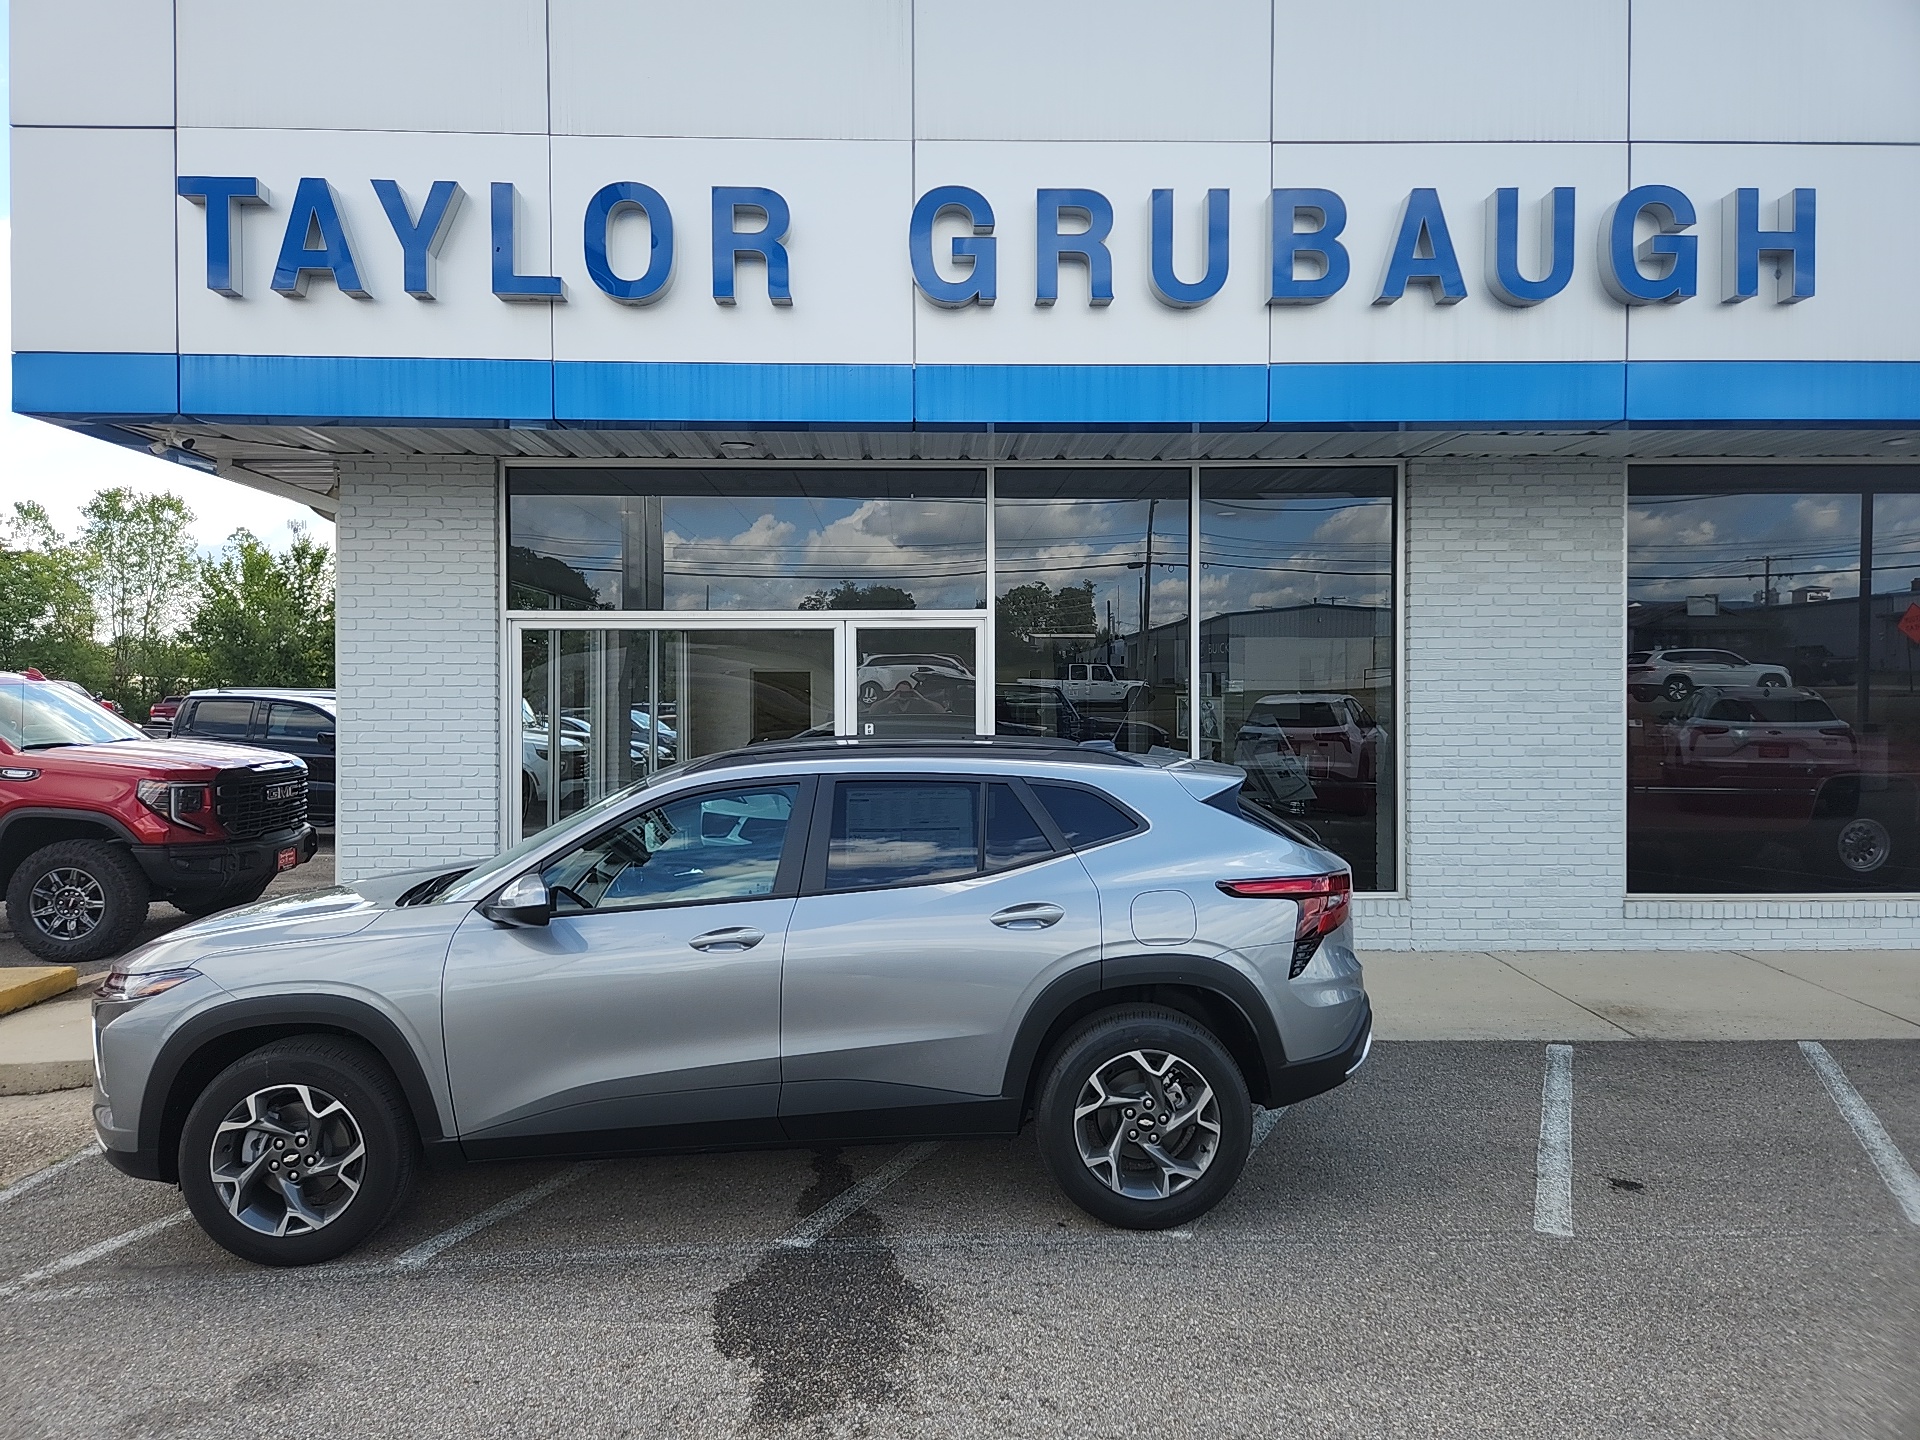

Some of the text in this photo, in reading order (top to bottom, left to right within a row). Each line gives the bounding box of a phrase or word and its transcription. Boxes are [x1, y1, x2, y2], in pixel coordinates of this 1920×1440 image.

[178, 176, 1817, 308] TAYLOR GRUBAUGH
[1208, 642, 1229, 654] BUICK
[266, 784, 299, 801] GMC
